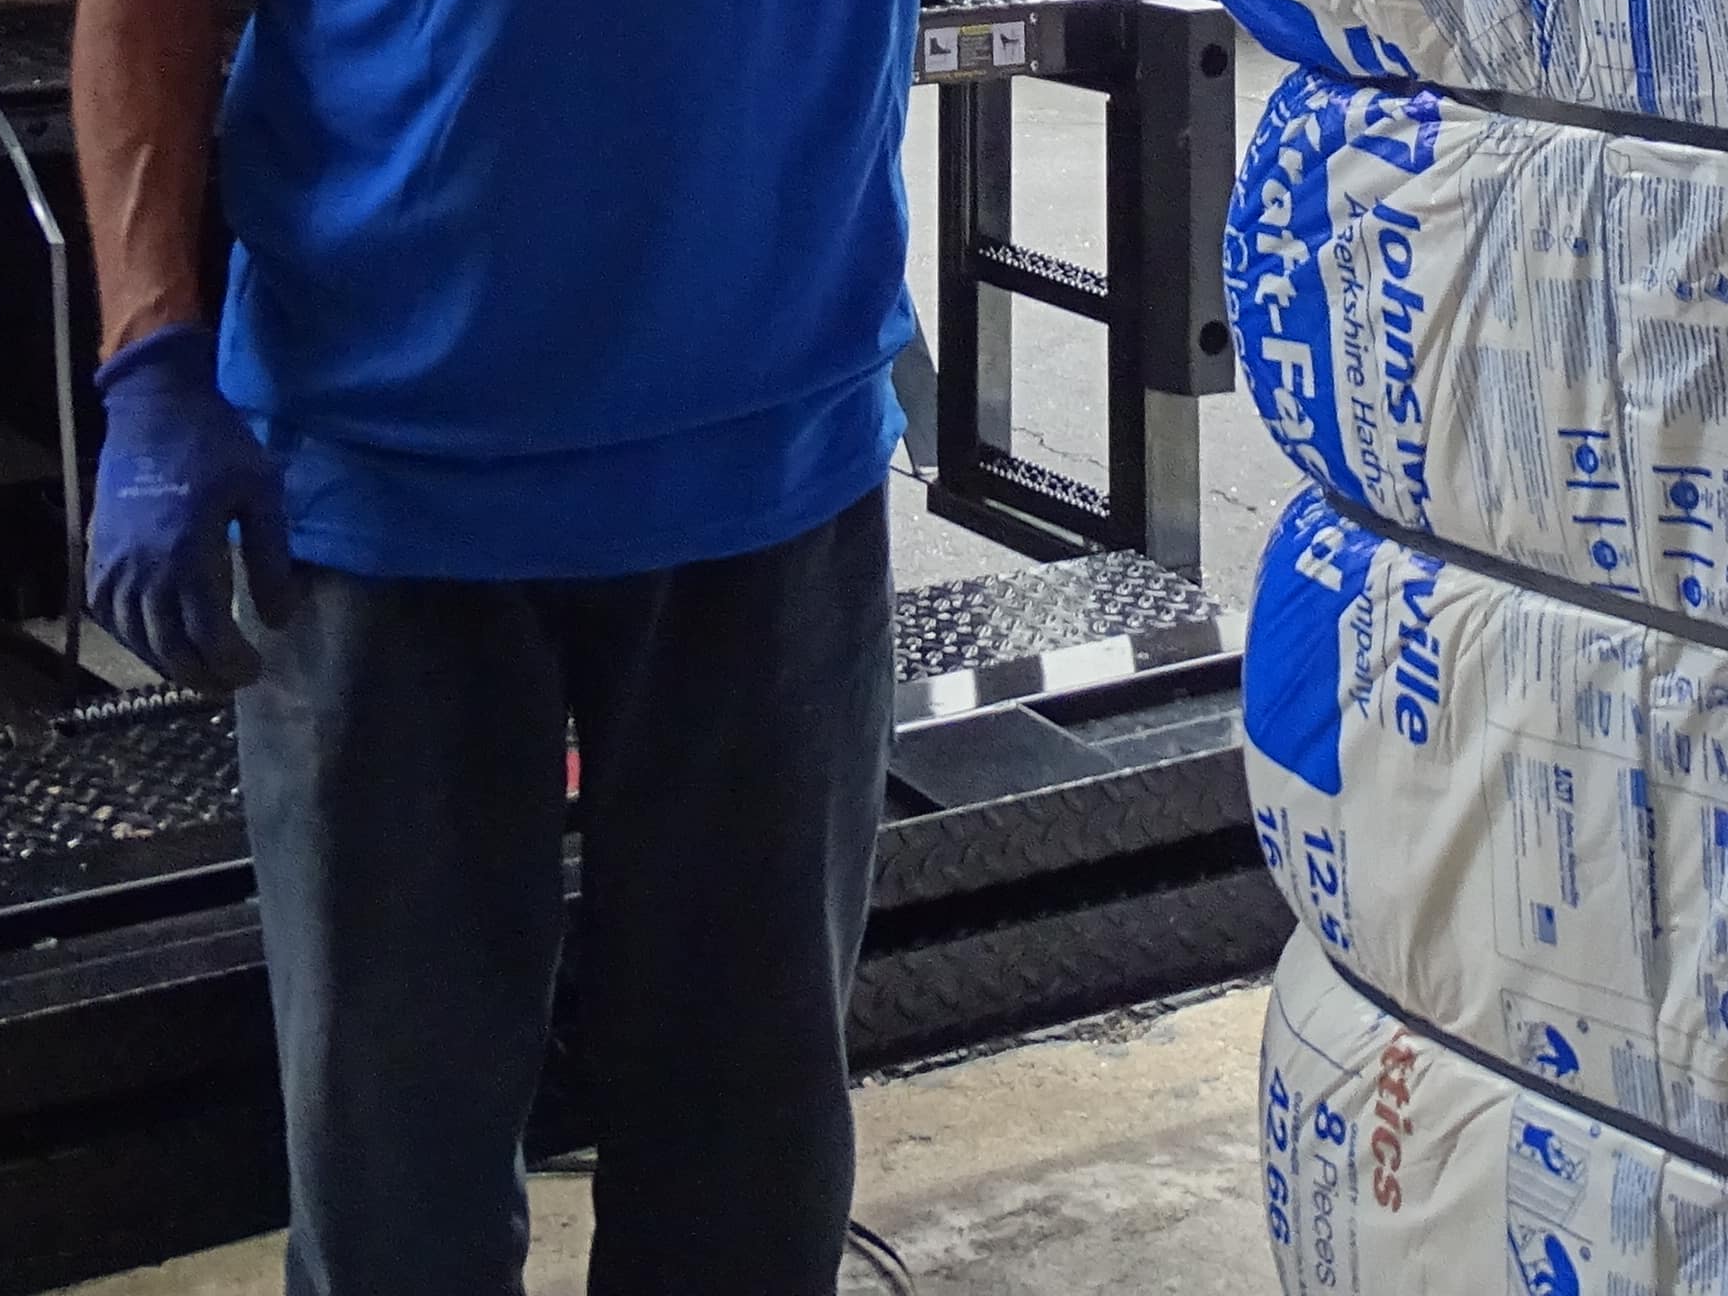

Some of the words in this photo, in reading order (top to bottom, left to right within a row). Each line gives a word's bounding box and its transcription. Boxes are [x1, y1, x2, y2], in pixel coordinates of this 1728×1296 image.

[1373, 200, 1425, 423] Johns
[1313, 1100, 1348, 1146] 8
[1370, 1028, 1418, 1214] ttics
[1312, 1153, 1340, 1288] Pieces
